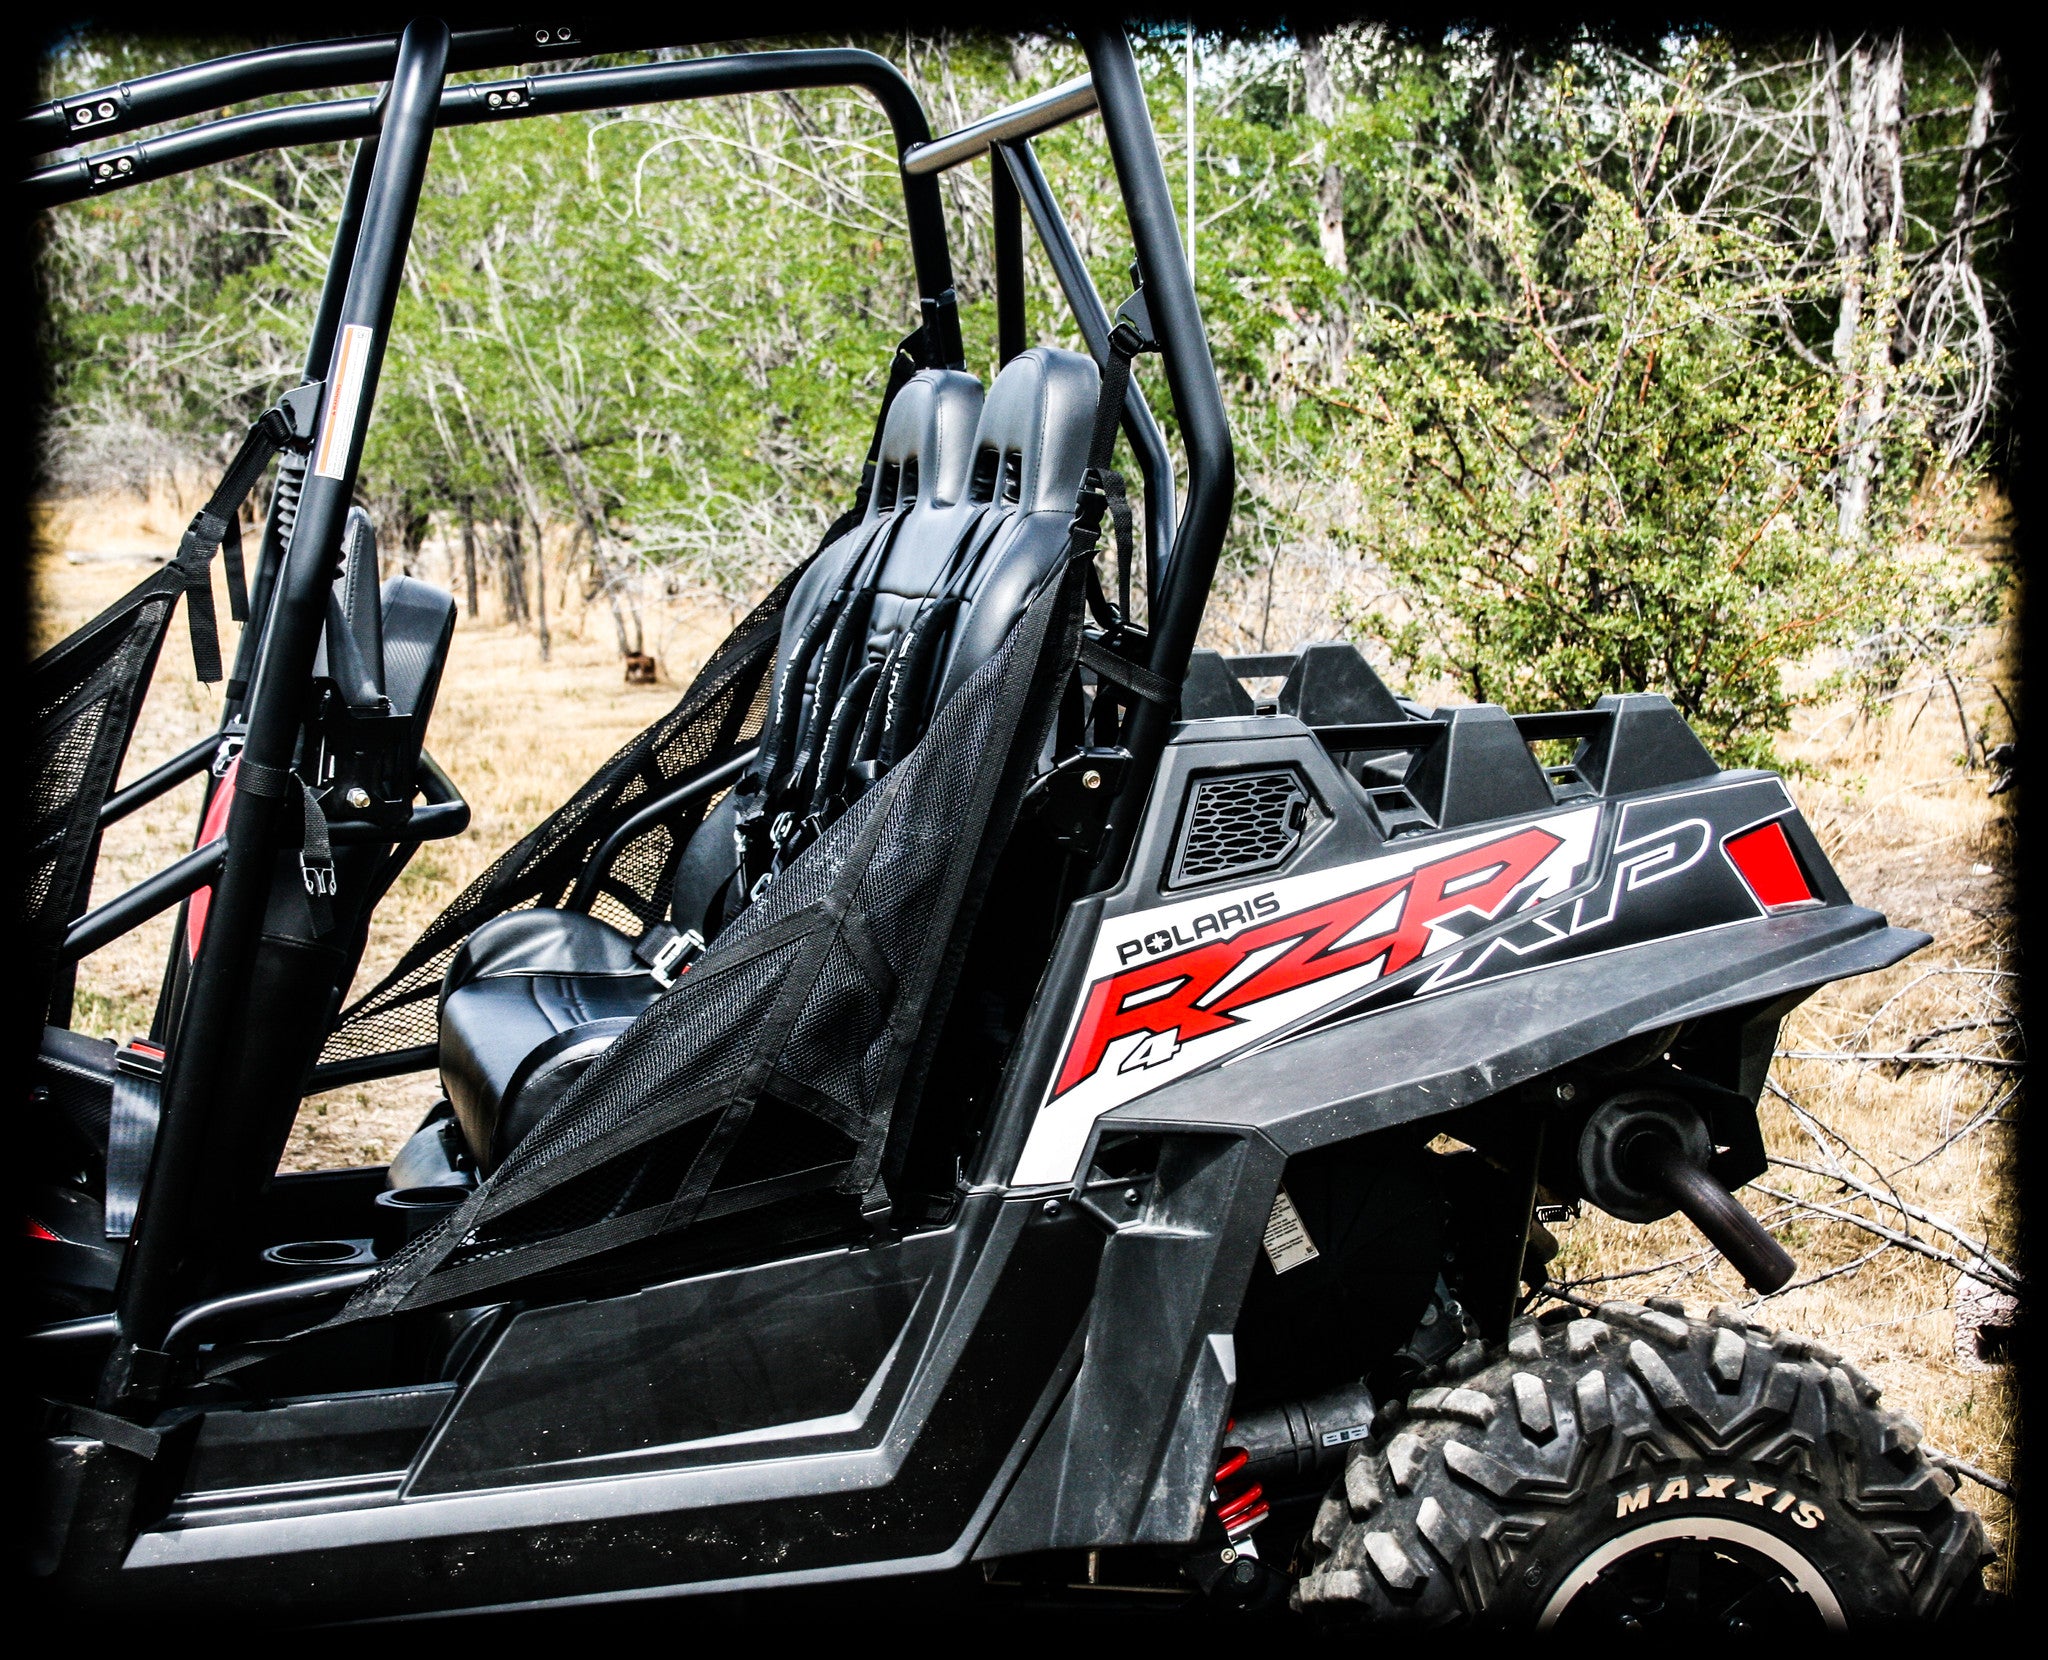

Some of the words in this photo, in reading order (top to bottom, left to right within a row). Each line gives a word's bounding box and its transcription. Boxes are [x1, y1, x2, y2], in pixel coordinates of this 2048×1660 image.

[1116, 892, 1280, 965] POLARIS
[1045, 826, 1566, 1108] RZR
[1413, 818, 1711, 996] XP
[1117, 1024, 1182, 1076] 4
[1616, 1474, 1825, 1529] MAXXIS
